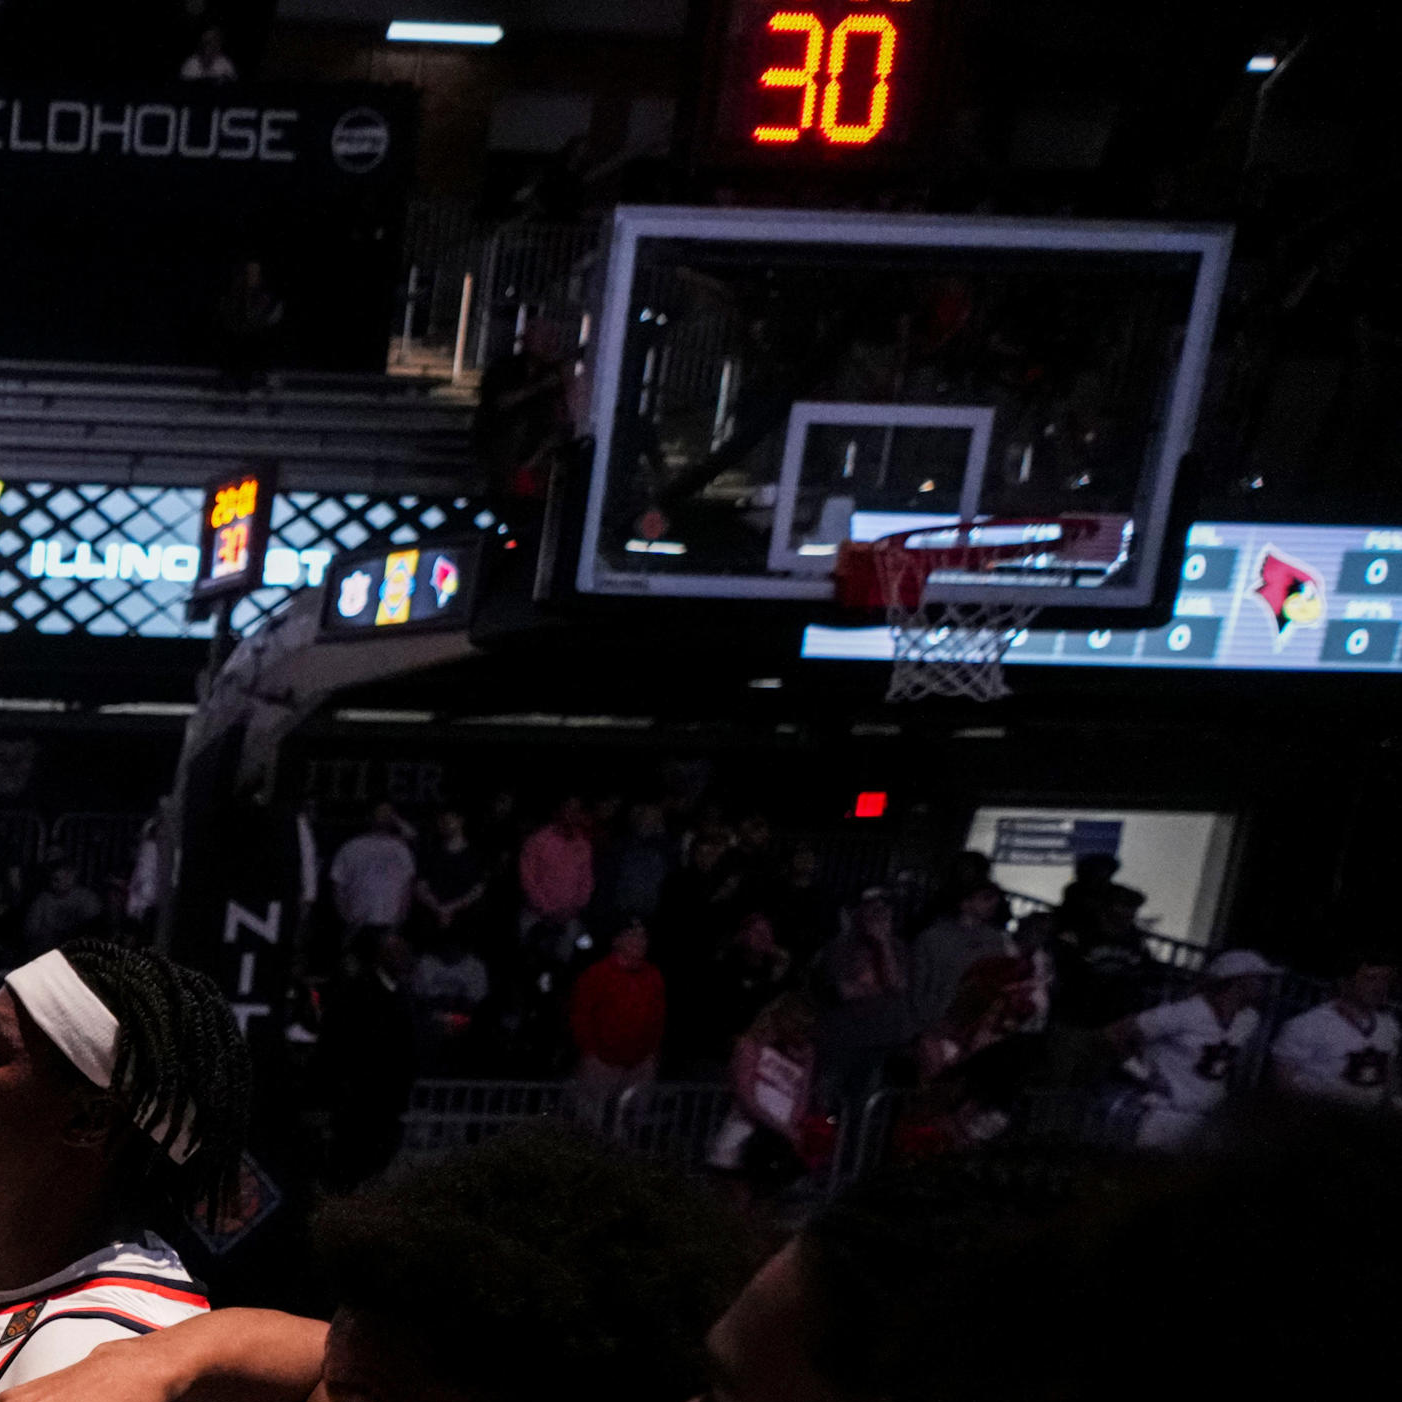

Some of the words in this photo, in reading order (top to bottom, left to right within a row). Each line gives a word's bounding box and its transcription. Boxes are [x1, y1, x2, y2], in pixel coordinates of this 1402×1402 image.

[753, 11, 897, 143] 30
[30, 540, 200, 582] ILLINO
[1182, 553, 1207, 581] 0
[1364, 557, 1389, 585] 0
[1167, 623, 1192, 652] 0
[1346, 627, 1370, 656] 0
